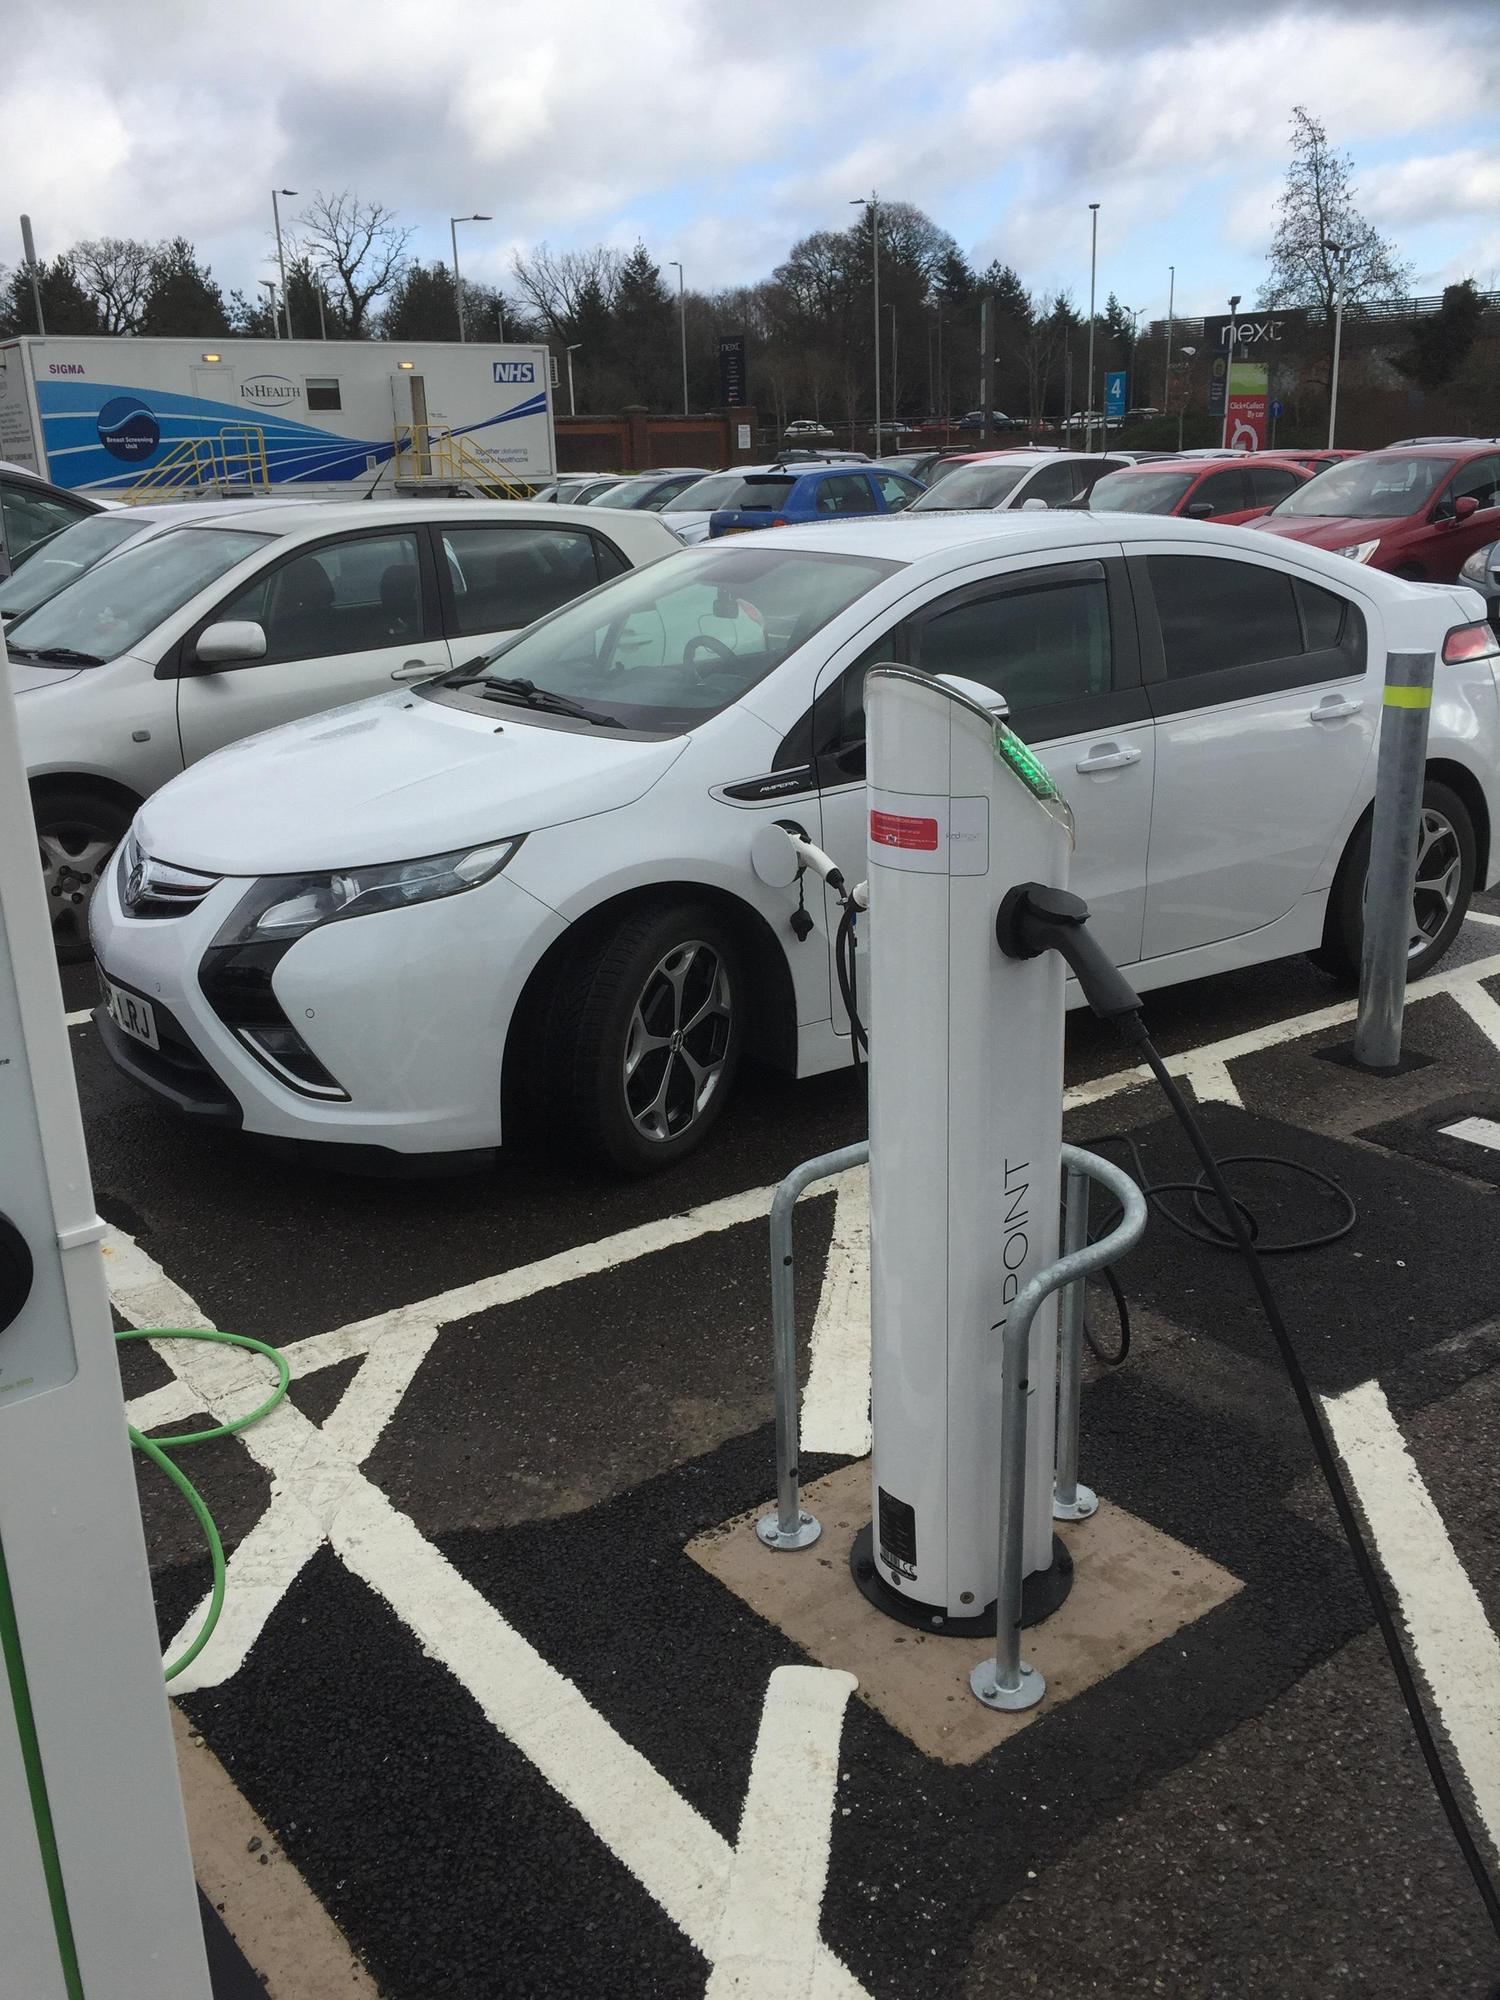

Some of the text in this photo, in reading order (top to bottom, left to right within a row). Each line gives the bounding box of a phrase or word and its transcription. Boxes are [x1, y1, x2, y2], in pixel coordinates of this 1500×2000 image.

[1221, 320, 1286, 345] next
[49, 364, 85, 375] SIGMA
[495, 364, 532, 382] NHS
[1111, 378, 1121, 398] 4
[760, 780, 799, 792] AMPERA
